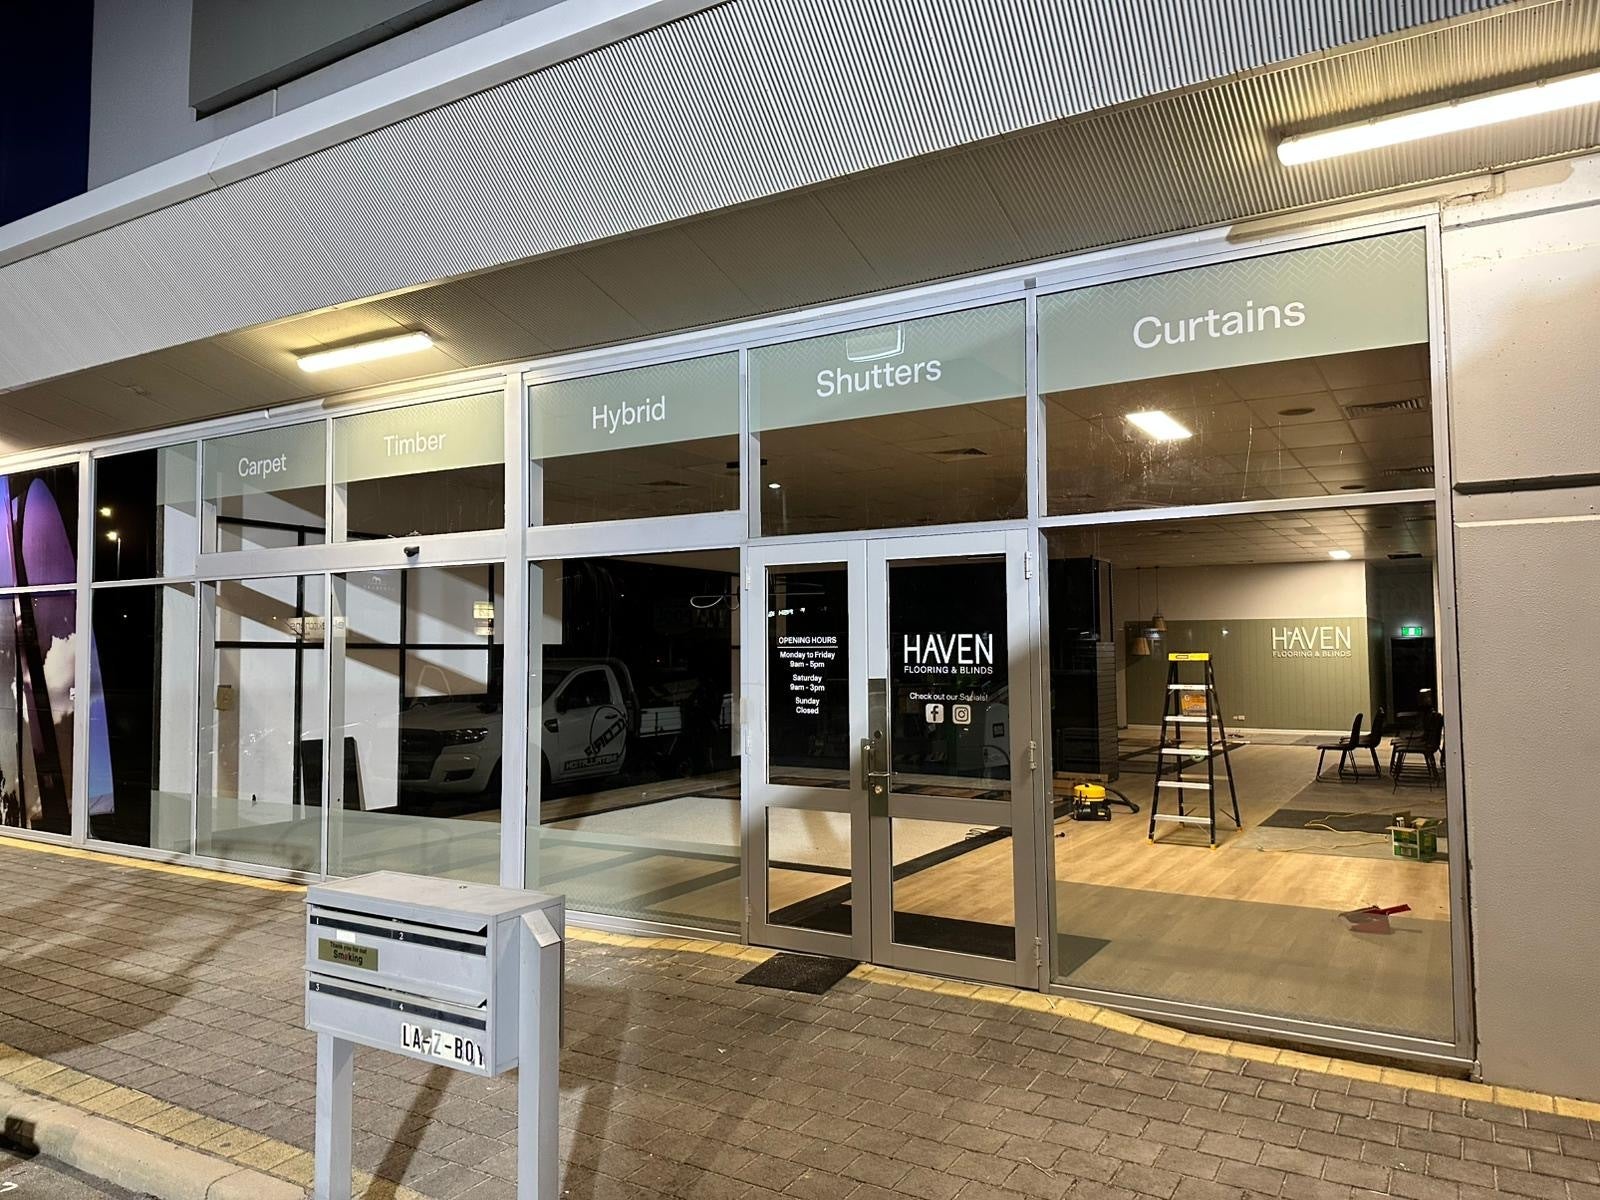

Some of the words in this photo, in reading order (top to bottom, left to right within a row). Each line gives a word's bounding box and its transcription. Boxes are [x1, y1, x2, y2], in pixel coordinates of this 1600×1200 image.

[1133, 299, 1306, 350] Curtains
[816, 359, 942, 398] Shutters
[592, 394, 666, 434] Hybrid
[383, 432, 447, 458] Timber
[238, 453, 288, 480] Carpet
[778, 636, 811, 645] OPENING
[811, 636, 838, 644] HOURS
[1271, 625, 1352, 650] HAVEN
[903, 633, 993, 664] HAVEN
[779, 651, 806, 660] Monday
[814, 650, 836, 660] Friday
[1272, 650, 1313, 658] FLOORING
[789, 660, 805, 668] 9am
[809, 660, 825, 669] 5pm
[903, 665, 949, 674] FLOORING
[951, 666, 958, 674] &
[959, 666, 994, 675] BLINDS
[792, 673, 823, 684] Saturday
[789, 683, 805, 691] 9am
[809, 683, 826, 693] 3pm
[795, 696, 820, 706] Sunday
[909, 692, 933, 701] Check
[932, 693, 946, 701] out
[945, 693, 959, 701] our
[959, 692, 989, 702] Socials!
[795, 706, 820, 715] Closed
[398, 931, 405, 940] 2
[333, 949, 363, 967] Smoking
[315, 983, 320, 991] 3
[398, 1003, 405, 1011] 4
